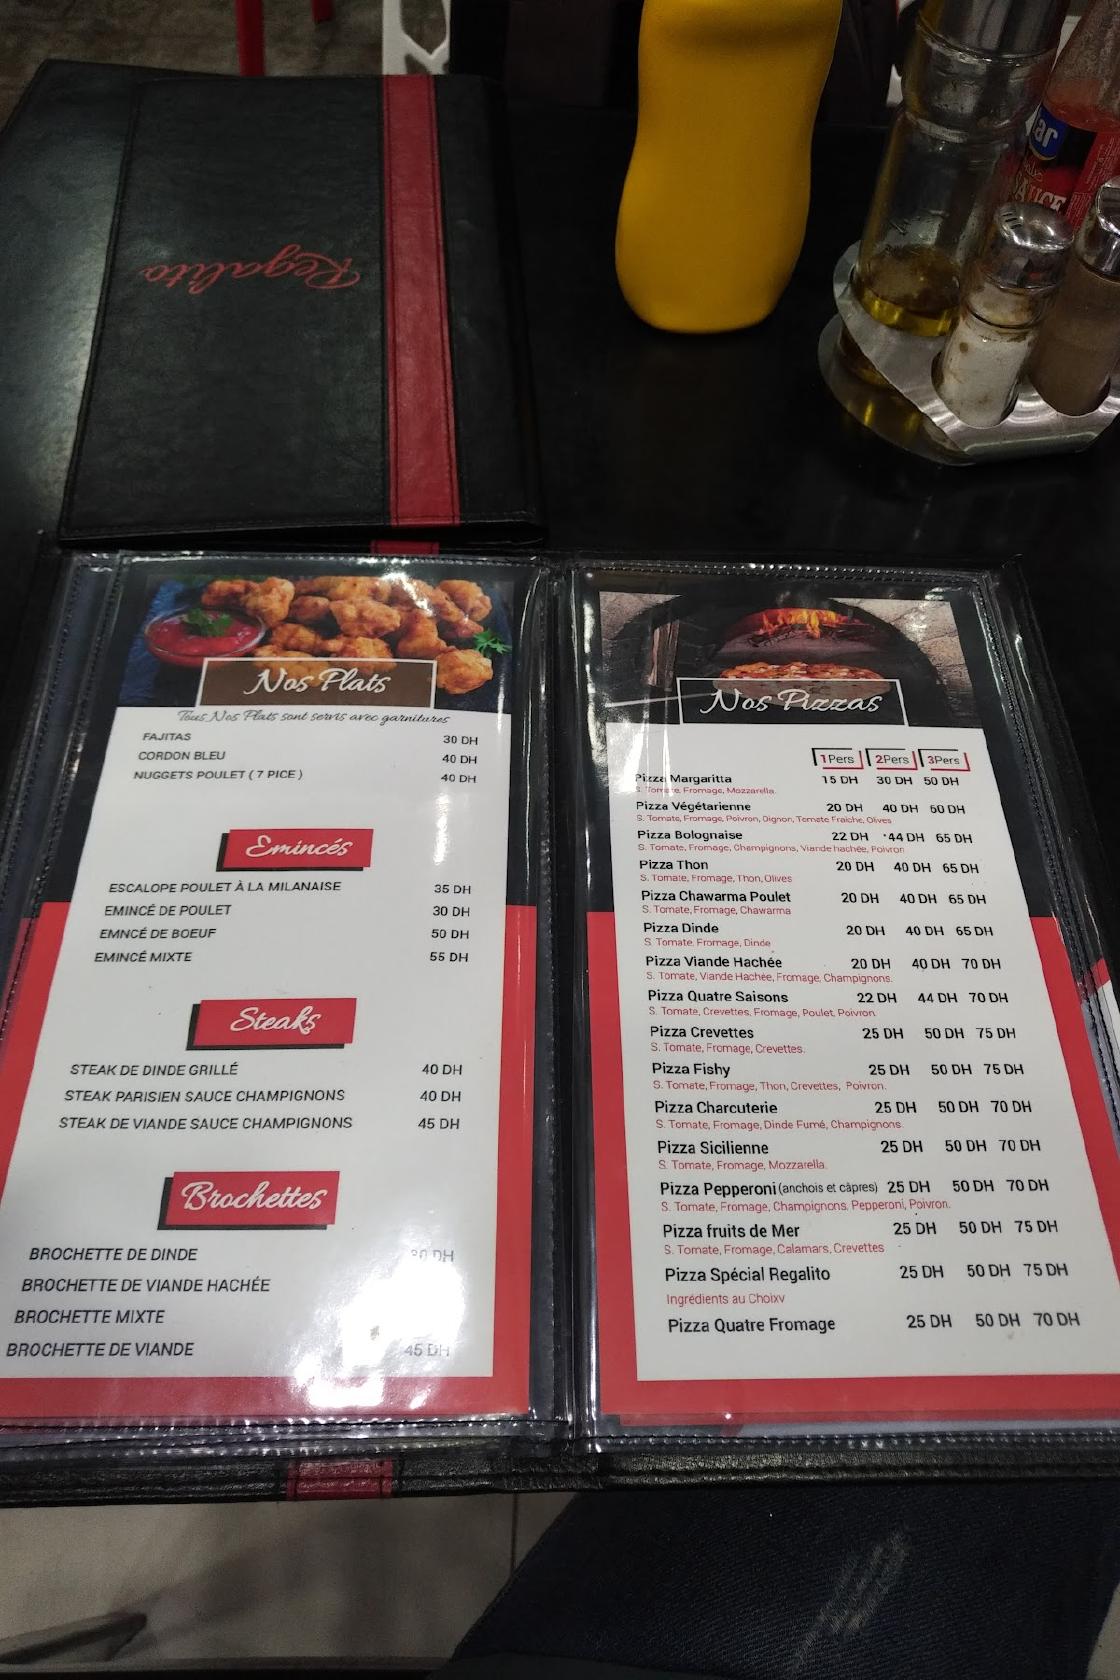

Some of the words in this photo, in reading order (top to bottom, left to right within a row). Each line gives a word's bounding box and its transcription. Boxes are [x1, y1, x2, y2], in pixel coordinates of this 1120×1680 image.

[140, 243, 361, 294] Regalito
[244, 667, 313, 695] Nos
[318, 668, 391, 694] Plats
[700, 689, 769, 714] Nos
[777, 689, 883, 713] Pizzas
[177, 710, 207, 722] Tous
[207, 711, 240, 723] Nos
[243, 710, 278, 722] Plats
[280, 712, 308, 722] sont
[310, 713, 347, 723] servis
[349, 713, 378, 723] avec
[380, 714, 450, 726] garnitures
[142, 733, 191, 741] FAJITAS
[443, 735, 457, 745] 30
[461, 736, 478, 745] DH
[138, 752, 190, 760] CORDON
[194, 751, 226, 760] BLEU
[442, 755, 456, 764] 40
[460, 755, 477, 764] DH
[820, 755, 854, 763] 1Pers
[876, 755, 909, 764] 2Pers
[928, 756, 959, 764] 3Pers
[133, 771, 193, 780] NUGGETS
[197, 770, 246, 779] POULET
[256, 770, 264, 779] 7
[267, 770, 296, 779] PICE
[441, 774, 455, 783] 40
[458, 774, 476, 784] DH
[636, 801, 668, 811] Pizza
[672, 802, 751, 812] Végétarienne
[637, 830, 671, 839] Pizza
[675, 830, 742, 841] Bolognaise
[245, 835, 353, 858] Emincés
[639, 860, 673, 870] Pizza
[677, 860, 708, 870] Thon
[108, 883, 177, 892] ESCALOPE
[180, 882, 232, 892] POULET
[234, 881, 244, 892] À
[248, 882, 264, 892] LA
[268, 882, 341, 892] MILANAISE
[434, 884, 449, 894] 35
[453, 885, 471, 894] DH
[641, 891, 676, 901] Pizza
[679, 891, 747, 902] Chawarma
[750, 891, 791, 902] Poulet
[104, 904, 156, 916] EMINCÉ
[159, 905, 176, 916] DE
[179, 905, 232, 916] POULET
[432, 906, 448, 916] 30
[452, 907, 470, 916] DH
[100, 927, 147, 939] EMNCÉ
[150, 928, 168, 939] DE
[171, 928, 217, 939] BOEUF
[643, 922, 678, 933] Pizza
[682, 923, 719, 933] Dinde
[431, 929, 446, 939] 50
[451, 929, 469, 939] DH
[94, 950, 147, 963] EMINCÉ
[150, 951, 192, 962] MIXTE
[429, 952, 445, 962] 55
[450, 952, 468, 962] DH
[646, 956, 681, 967] Pizza
[684, 956, 730, 968] Viande
[734, 957, 782, 968] Hachée
[648, 990, 684, 1002] Pizza
[688, 991, 732, 1002] Quatre
[736, 991, 788, 1003] Saisons
[230, 1005, 322, 1033] Steaks
[650, 1026, 686, 1038] Pizza
[690, 1027, 754, 1038] Crevettes
[70, 1064, 117, 1075] STEAK
[120, 1064, 139, 1076] DE
[141, 1064, 185, 1076] DINDE
[188, 1062, 239, 1076] GRILLÉ
[422, 1064, 438, 1075] 40
[442, 1064, 462, 1075] DH
[652, 1062, 689, 1075] Pizza
[693, 1063, 730, 1078] Fishy
[868, 1064, 885, 1075] 25
[889, 1064, 909, 1075] DH
[931, 1064, 948, 1075] 50
[952, 1064, 972, 1075] DH
[983, 1064, 1000, 1074] 75
[1004, 1064, 1024, 1074] DH
[64, 1090, 112, 1101] STEAK
[115, 1090, 181, 1102] PARISIEN
[185, 1090, 232, 1102] SAUCE
[236, 1090, 345, 1102] CHAMPIGNONS
[420, 1091, 437, 1102] 40
[441, 1091, 461, 1102] DH
[655, 1100, 693, 1114] Pizza
[697, 1101, 778, 1114] Charcuterie
[59, 1117, 106, 1129] STEAK
[110, 1117, 129, 1129] DE
[132, 1118, 187, 1129] VIANDE
[190, 1117, 238, 1129] SAUCE
[242, 1117, 353, 1129] CHAMPIGNONS
[418, 1118, 435, 1129] 45
[439, 1118, 460, 1129] DH
[657, 1141, 695, 1154] Pizza
[700, 1141, 768, 1154] Sicilienne
[660, 1182, 699, 1195] Pizza
[703, 1182, 777, 1197] Pepperoni
[779, 1182, 823, 1195] (anchois
[826, 1183, 837, 1193] et
[839, 1182, 878, 1194] câpres)
[180, 1179, 328, 1211] Brochettes
[663, 1224, 703, 1237] Pizza
[706, 1224, 746, 1238] fruits
[749, 1224, 767, 1237] de
[772, 1224, 799, 1237] Mer
[833, 1243, 884, 1253] Crevettes
[29, 1248, 123, 1261] BROCHETTE
[126, 1248, 147, 1261] DE
[150, 1248, 198, 1261] DINDE
[665, 1267, 706, 1282] Pizza
[710, 1267, 765, 1283] Spécial
[769, 1267, 830, 1283] Regalito
[21, 1278, 118, 1292] BROCHETTE
[121, 1278, 142, 1292] DE
[146, 1278, 203, 1292] VIANDE
[207, 1276, 270, 1292] HACHÉE
[667, 1294, 728, 1307] Ingrédients
[732, 1295, 745, 1305] au
[14, 1310, 112, 1323] BROCHETTE
[115, 1310, 165, 1323] MIXTE
[668, 1318, 709, 1333] Pizza
[714, 1318, 765, 1333] Quatre
[769, 1318, 835, 1334] Fromage
[6, 1343, 106, 1356] BROCHETTE
[108, 1343, 131, 1356] DE
[134, 1343, 194, 1356] VIANDE
